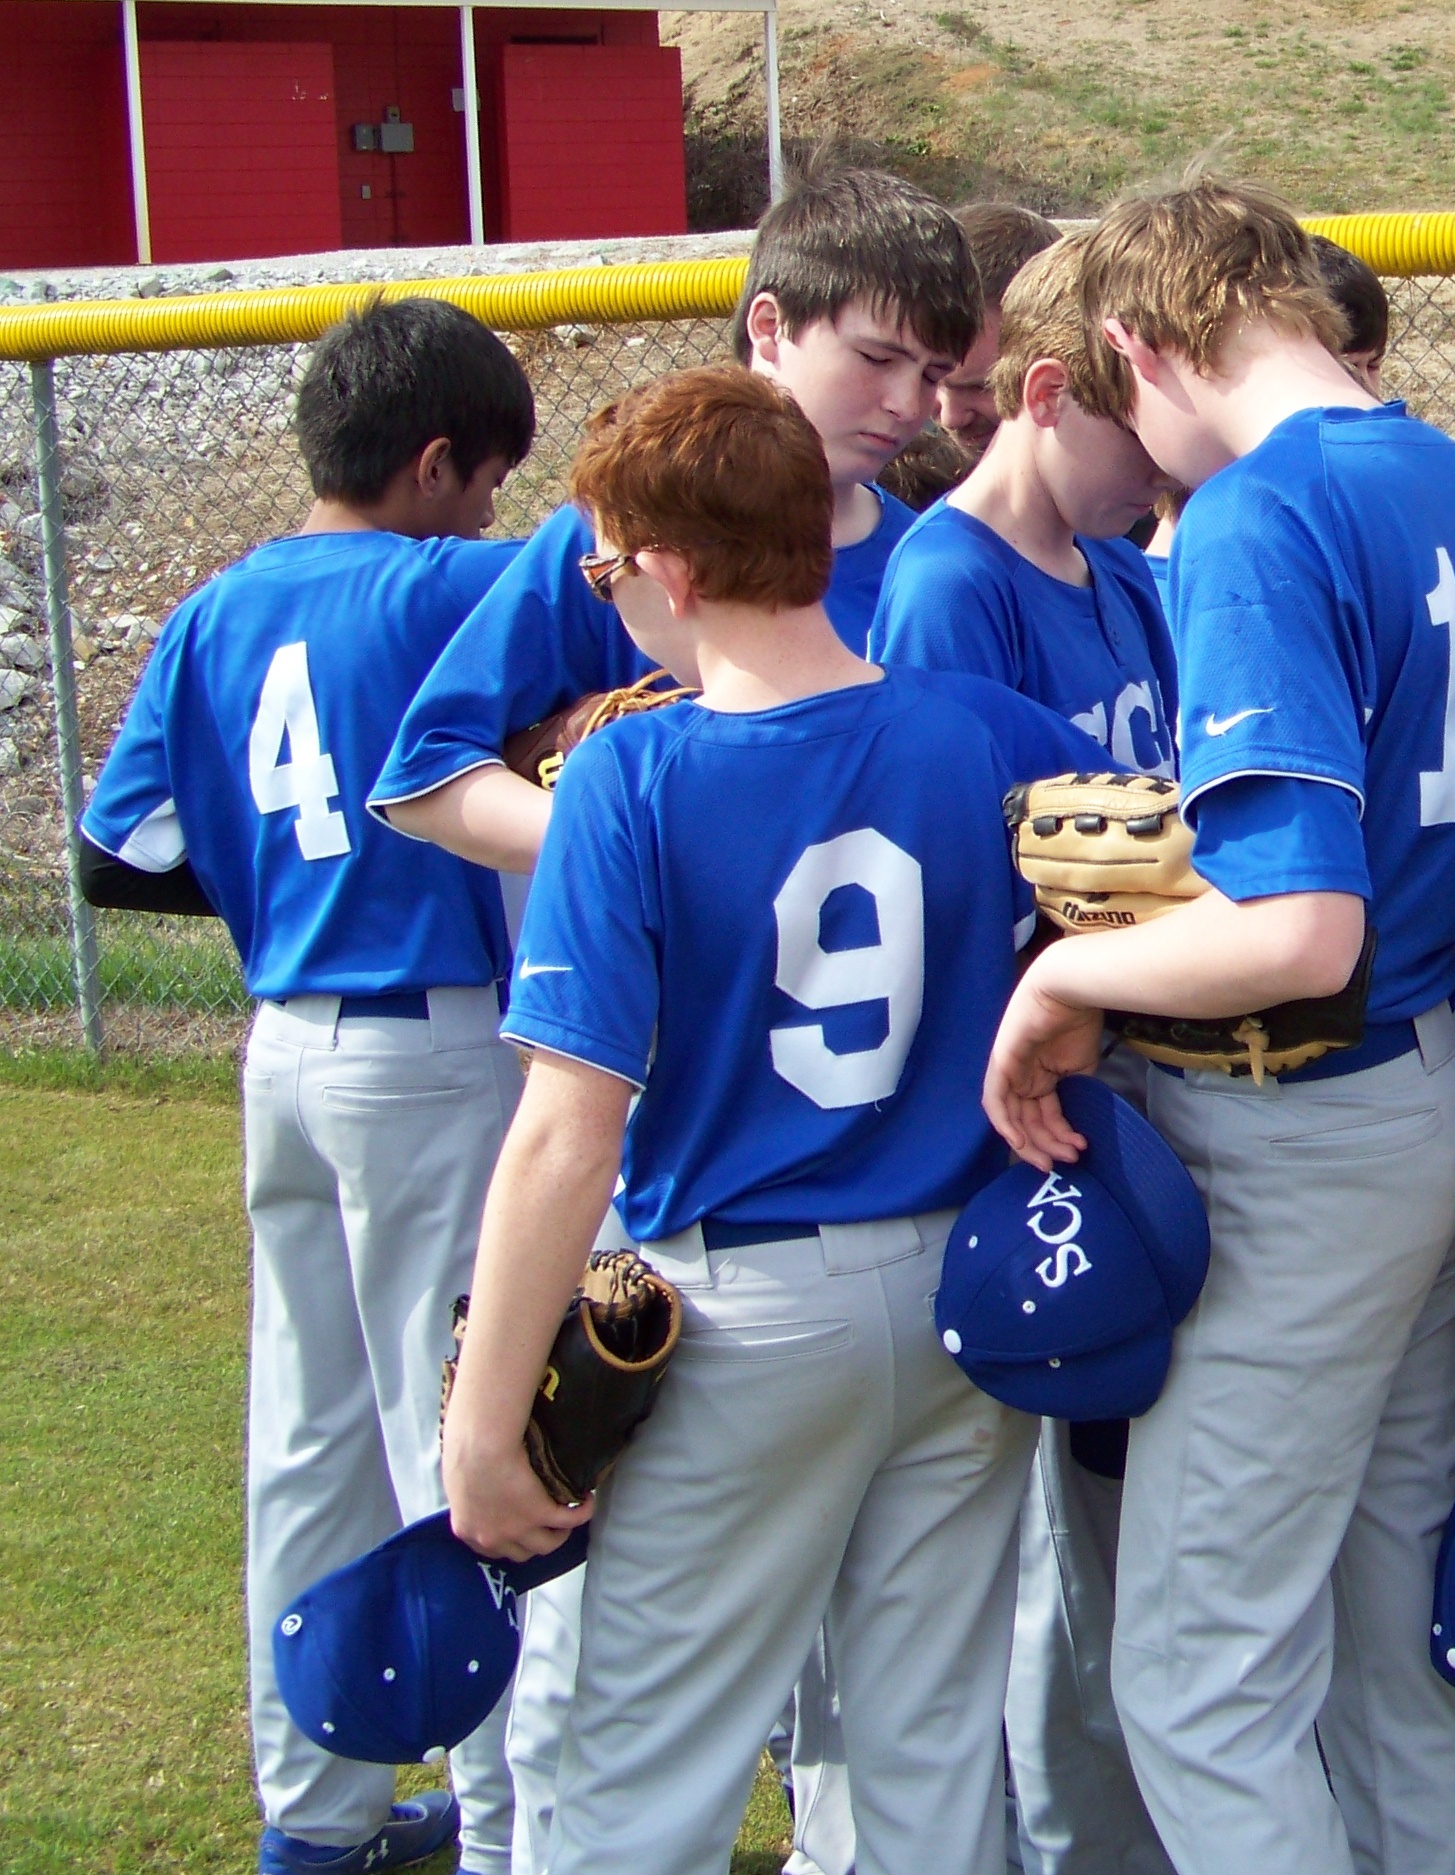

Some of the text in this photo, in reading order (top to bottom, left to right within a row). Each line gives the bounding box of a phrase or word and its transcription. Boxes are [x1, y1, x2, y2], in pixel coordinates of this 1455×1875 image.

[249, 641, 351, 860] 4
[769, 827, 926, 1109] 9
[1026, 1171, 1093, 1288] SCA
